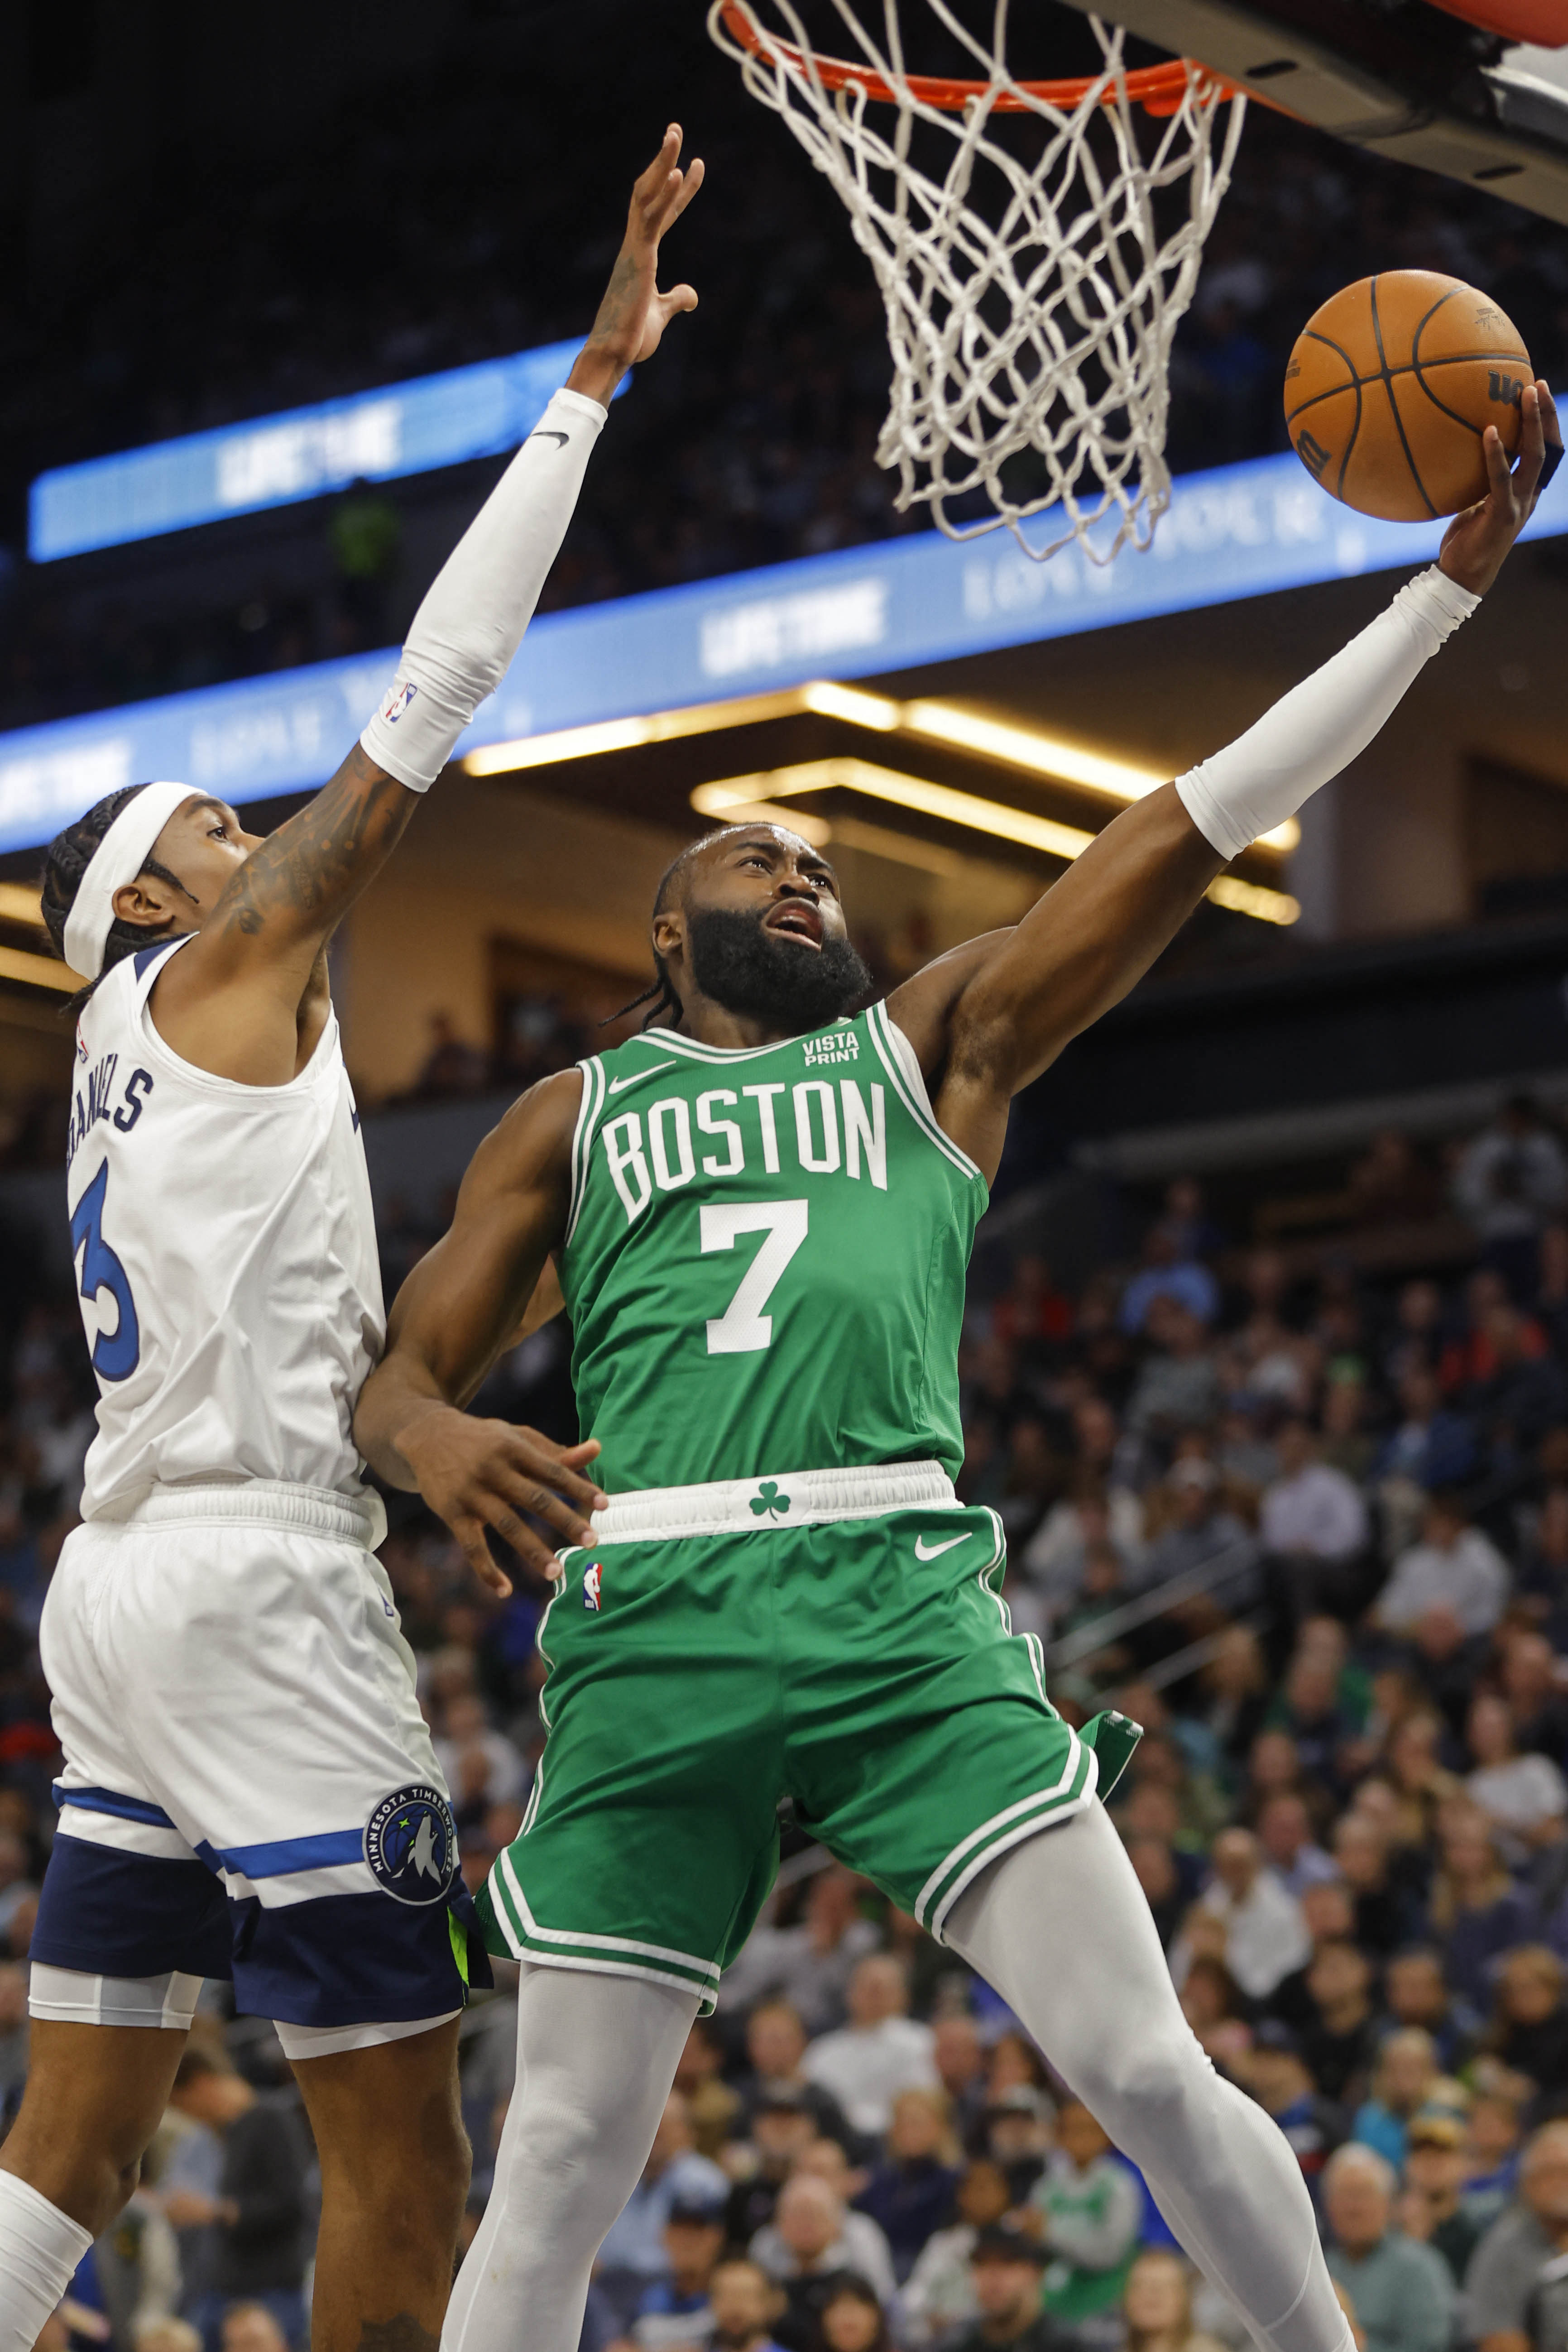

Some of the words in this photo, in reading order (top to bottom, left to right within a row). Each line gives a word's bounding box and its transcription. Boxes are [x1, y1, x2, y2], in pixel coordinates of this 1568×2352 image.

[802, 1031, 859, 1056] VISTA
[805, 1046, 859, 1067] PRINT
[602, 1079, 887, 1225] BOSTON
[70, 1156, 139, 1382] 3
[700, 1199, 809, 1355] 7
[369, 1794, 407, 1873] MINNESOTA
[412, 1788, 453, 1873] TIMBERWOLVES
